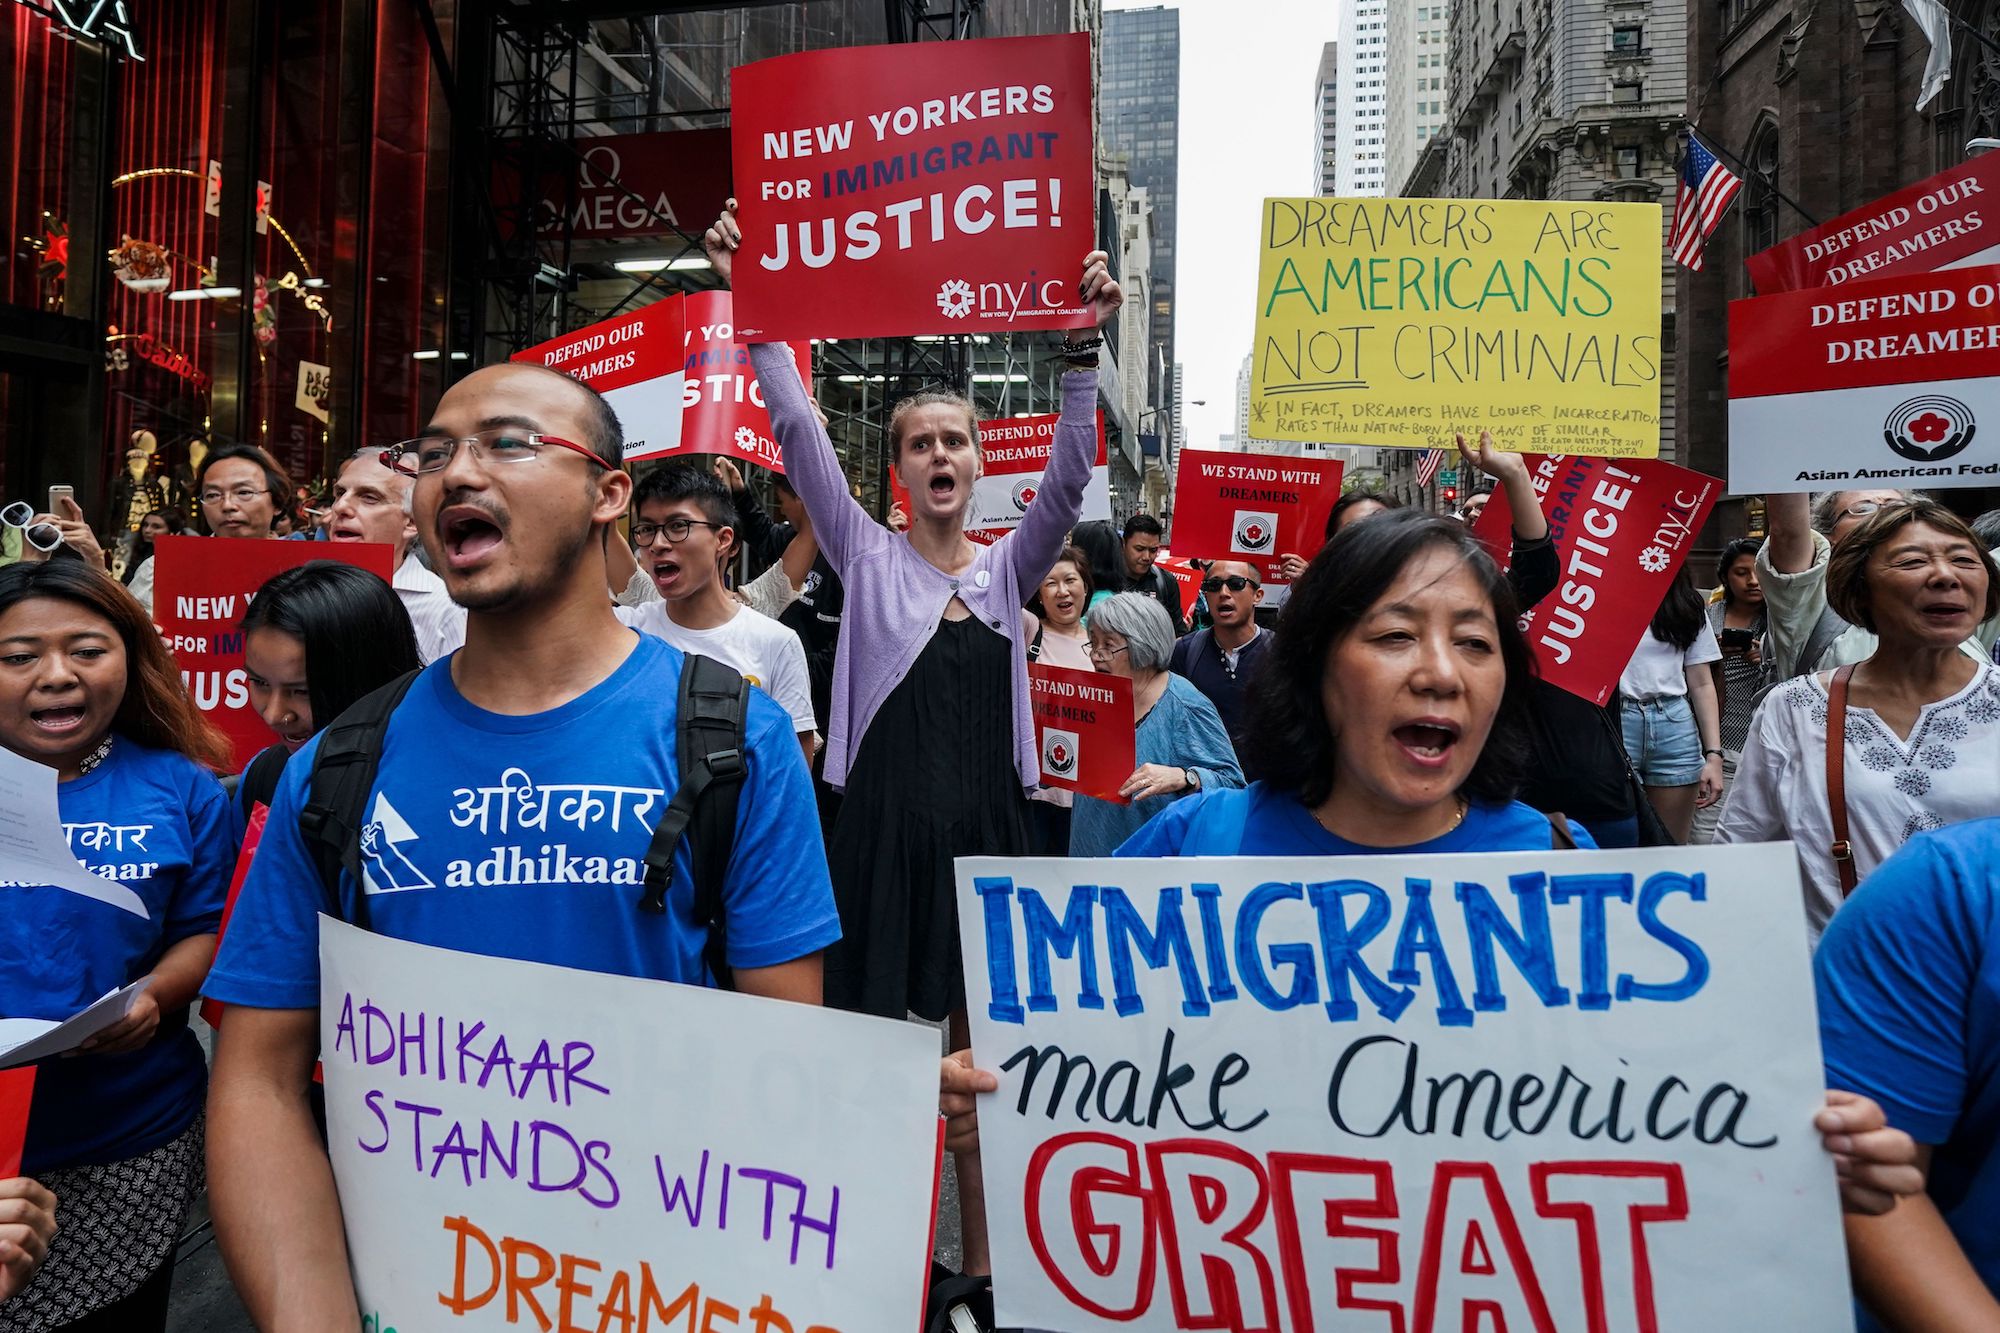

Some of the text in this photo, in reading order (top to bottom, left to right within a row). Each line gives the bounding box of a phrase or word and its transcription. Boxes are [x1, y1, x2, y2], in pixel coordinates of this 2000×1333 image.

[763, 84, 1055, 160] NEW YORKERS
[761, 132, 1059, 200] FOR IMMIGRANT
[759, 178, 1063, 271] JUSTICE!
[1269, 200, 1620, 254] DREAMERS ARE
[1803, 176, 1985, 263] DEFEND OUR
[1826, 211, 1984, 286] DREAMERS
[979, 270, 1065, 323] nyic
[1016, 309, 1055, 317] IMMIGRATION
[1266, 256, 1614, 318] AMERICANS
[1811, 287, 1957, 327] DEFEND
[544, 321, 645, 368] DEFEND OUR
[1263, 324, 1657, 387] NOT CRIMINALS
[978, 425, 1034, 442] DEFEND
[1323, 421, 1358, 433] THAN
[1533, 424, 1551, 437] OF
[1441, 405, 1480, 420] HAVE
[1201, 464, 1321, 485] WE STAND WITH
[1219, 487, 1300, 504] DREAMERS
[1795, 463, 2000, 481] Asian American Fed
[1653, 490, 1697, 548] nyic
[1540, 465, 1642, 665] JUSTICE!
[177, 595, 236, 619] NEW
[174, 635, 207, 653] FOR
[1035, 679, 1075, 697] STAND
[1077, 685, 1114, 704] WITH
[449, 767, 665, 836] अधिकार
[974, 870, 1712, 1027] IMMIGRANTS
[336, 992, 610, 1106] ADHIKAAR
[999, 1026, 1780, 1150] make America
[358, 1090, 840, 1270] STANDS WITH
[1024, 1130, 1691, 1333] GREAT
